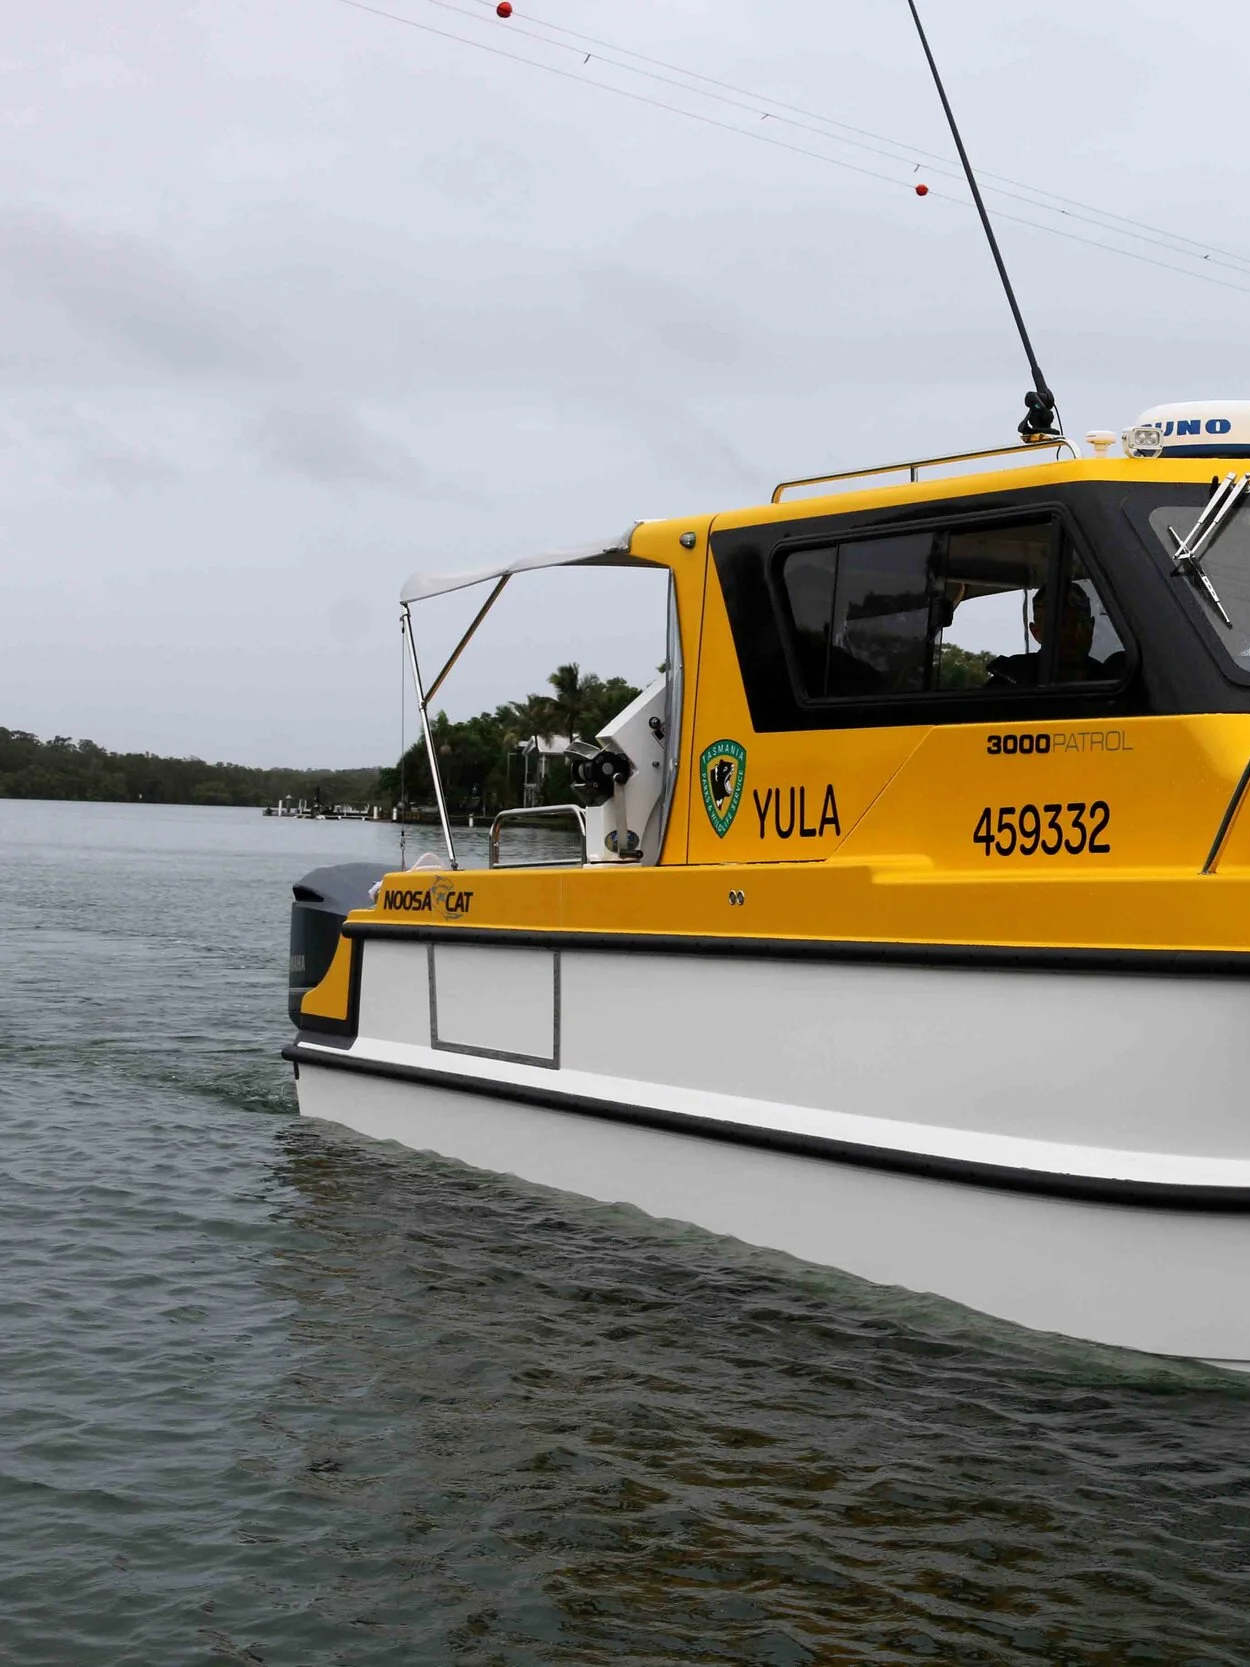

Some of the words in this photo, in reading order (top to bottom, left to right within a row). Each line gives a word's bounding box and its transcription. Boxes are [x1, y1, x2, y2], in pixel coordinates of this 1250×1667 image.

[1141, 419, 1232, 437] UNO
[702, 743, 745, 764] TASMANIA
[702, 772, 712, 803] PARKS
[730, 769, 744, 812] SERVICE
[753, 784, 841, 839] YULA
[973, 800, 1111, 857] 459332
[383, 890, 432, 911] NOOSA
[445, 891, 474, 913] CAT
